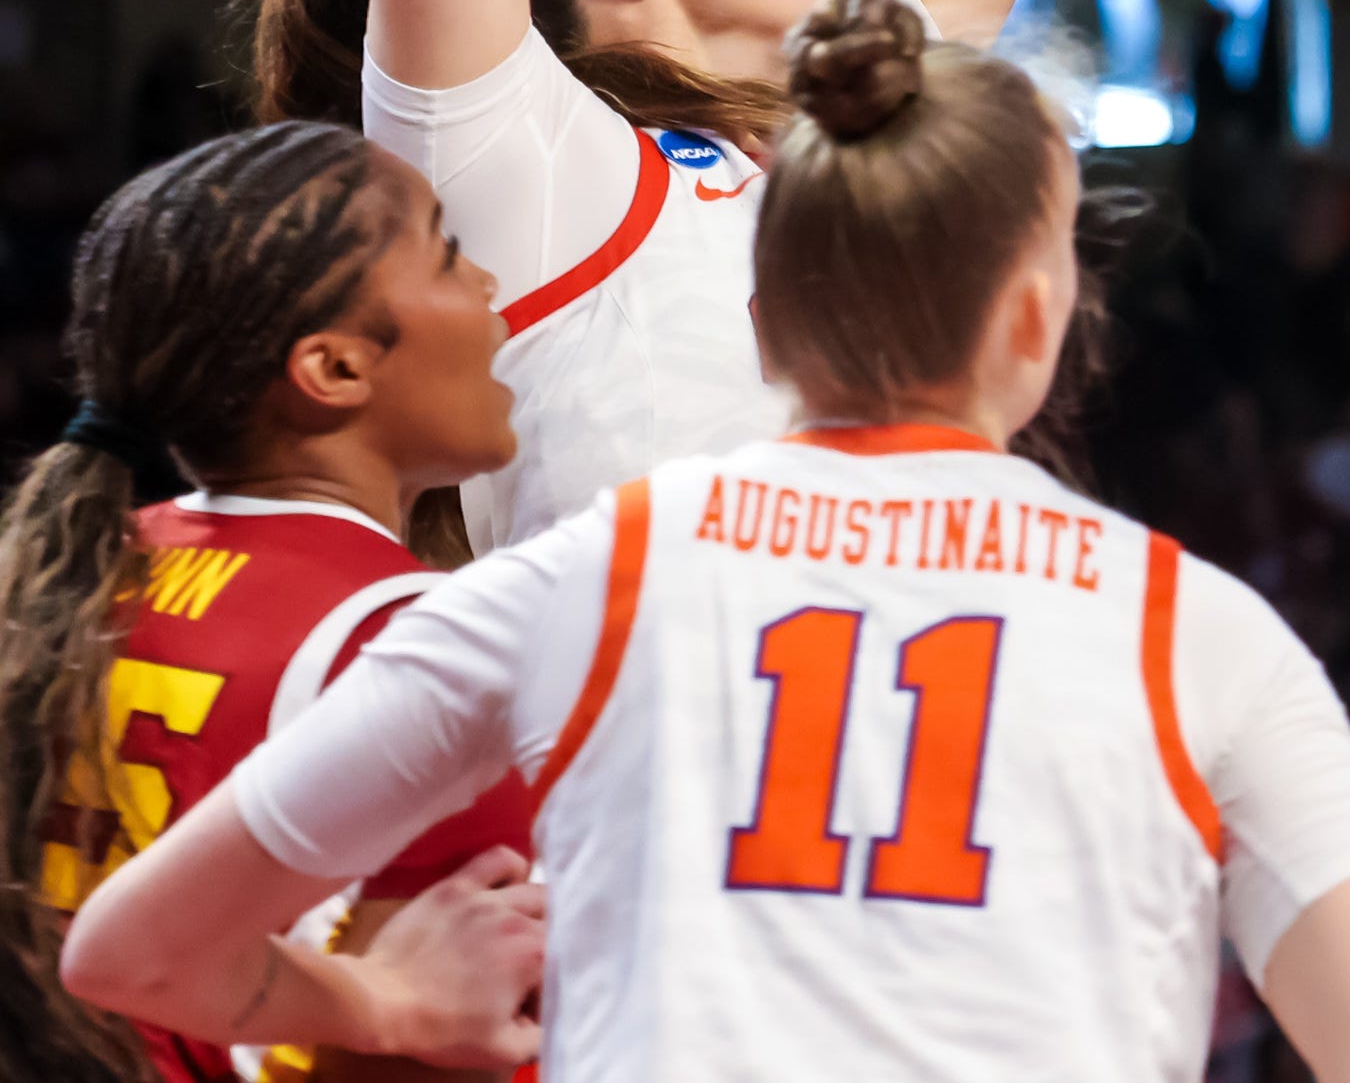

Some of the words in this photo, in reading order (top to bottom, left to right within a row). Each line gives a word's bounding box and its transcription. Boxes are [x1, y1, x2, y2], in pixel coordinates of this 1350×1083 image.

[670, 146, 718, 160] NCAA
[695, 475, 1103, 593] AUGUSTINAITE
[721, 605, 1005, 908] 11
